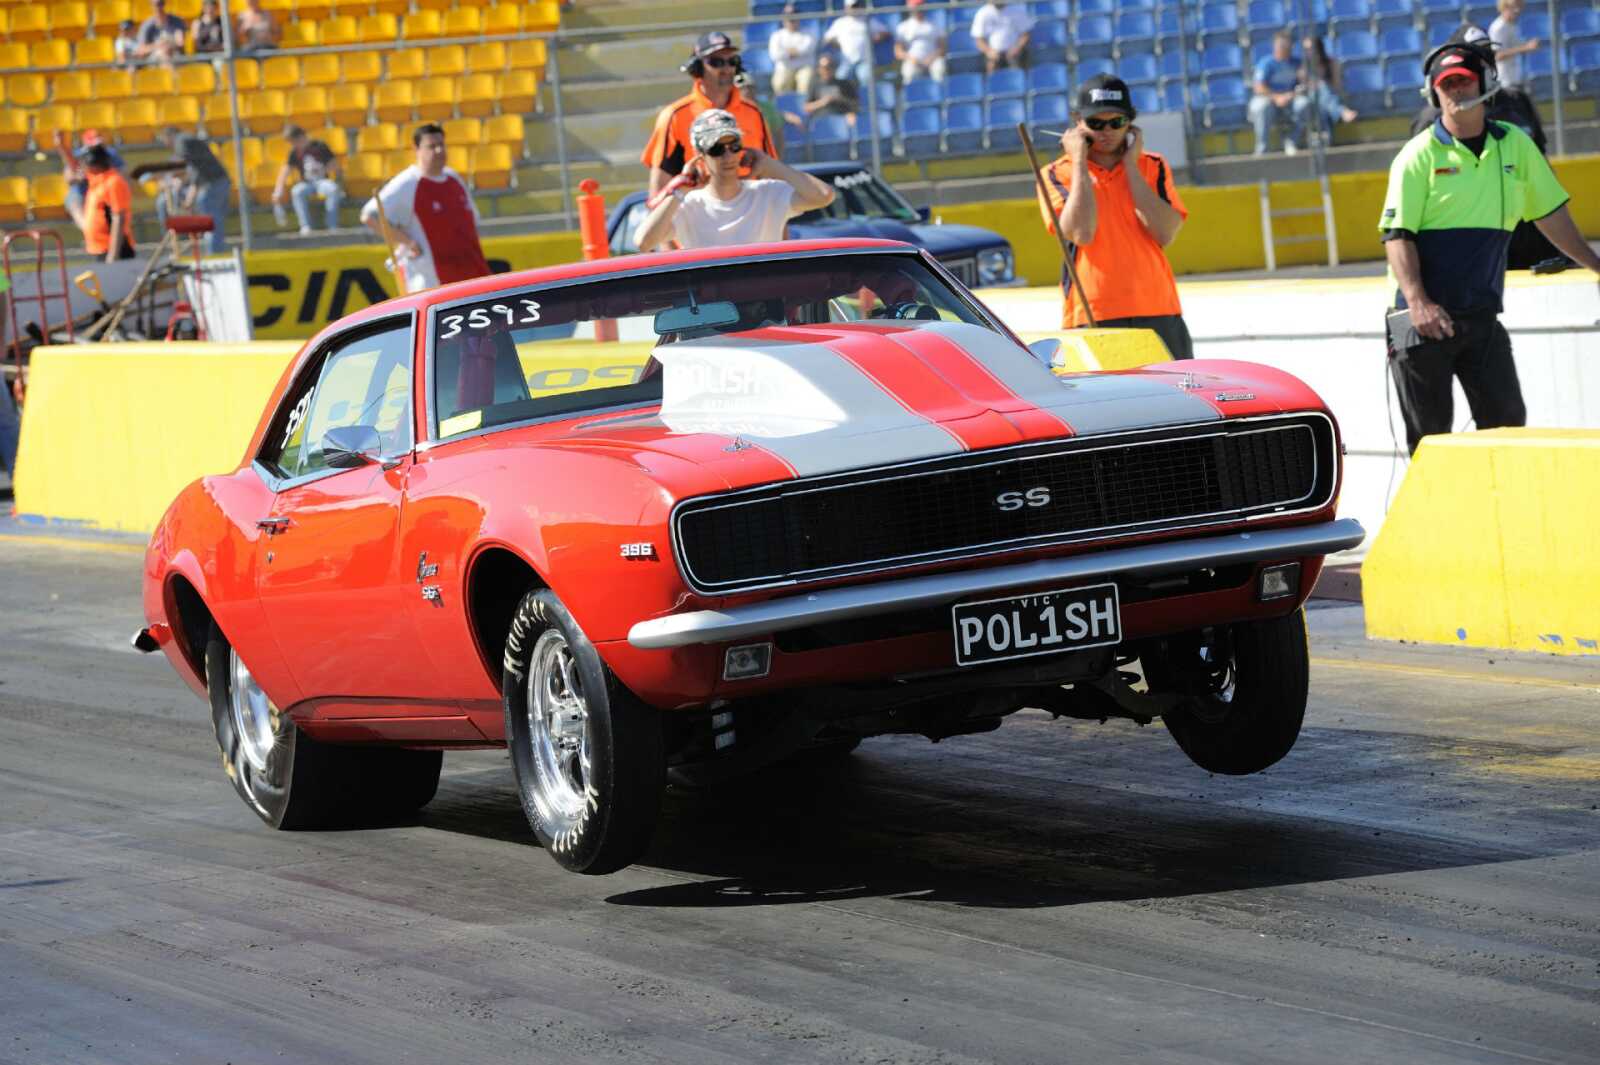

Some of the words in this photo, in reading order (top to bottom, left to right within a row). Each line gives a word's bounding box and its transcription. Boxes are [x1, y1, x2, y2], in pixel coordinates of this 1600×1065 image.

[440, 299, 541, 339] 3593
[996, 486, 1051, 511] SS
[619, 543, 652, 557] 396
[1020, 595, 1050, 609] VIC
[959, 597, 1116, 656] POL1SH
